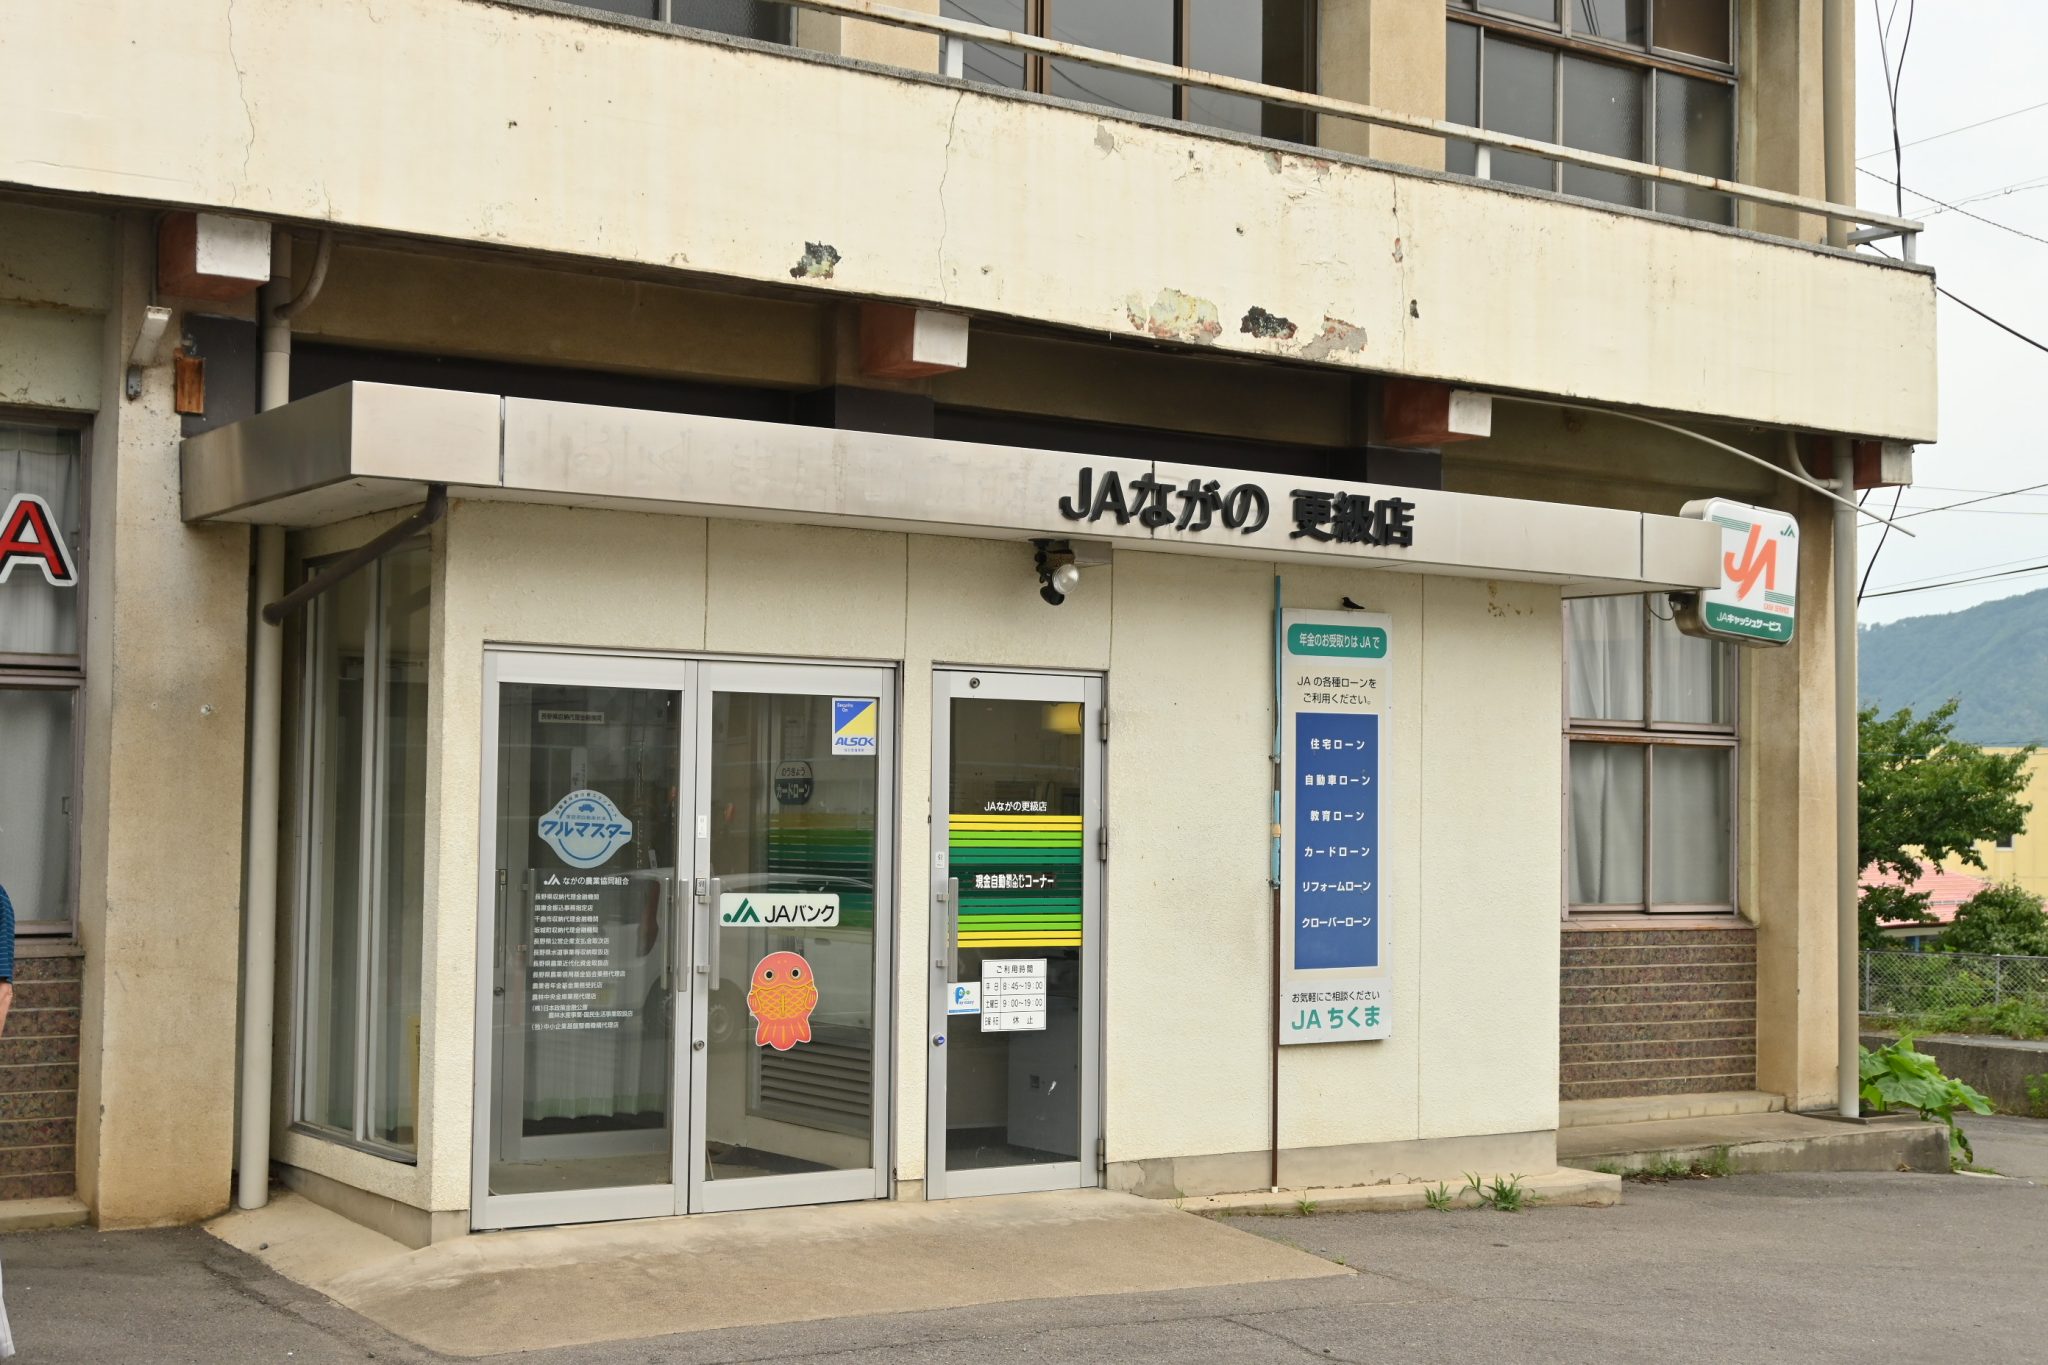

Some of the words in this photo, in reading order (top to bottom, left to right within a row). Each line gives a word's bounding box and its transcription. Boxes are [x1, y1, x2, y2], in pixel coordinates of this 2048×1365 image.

[1059, 467, 1269, 534] JAながの
[1290, 489, 1415, 547] 更級店
[1717, 611, 1782, 632] JAキャッシュサービス
[1303, 693, 1371, 705] ご利用ください。
[835, 737, 874, 746] ALSOK
[1311, 738, 1365, 750] 住宅ローン
[1305, 774, 1370, 786] 自動車ローン
[776, 783, 811, 799] カードローン
[984, 801, 1047, 812] JAながの更級店
[1311, 810, 1364, 822] 教育ローン
[541, 821, 631, 838] クルマスター
[1304, 846, 1369, 857] カードローン
[563, 877, 629, 886] ながの農業協同組合
[1302, 881, 1371, 893] リフォームローン
[765, 905, 835, 923] JAバンク
[1302, 917, 1371, 928] クローバーローン
[996, 965, 1034, 974] ご利用時間
[1292, 990, 1380, 1003] お気軽にご相談ください
[1291, 1005, 1380, 1030] JAちくま
